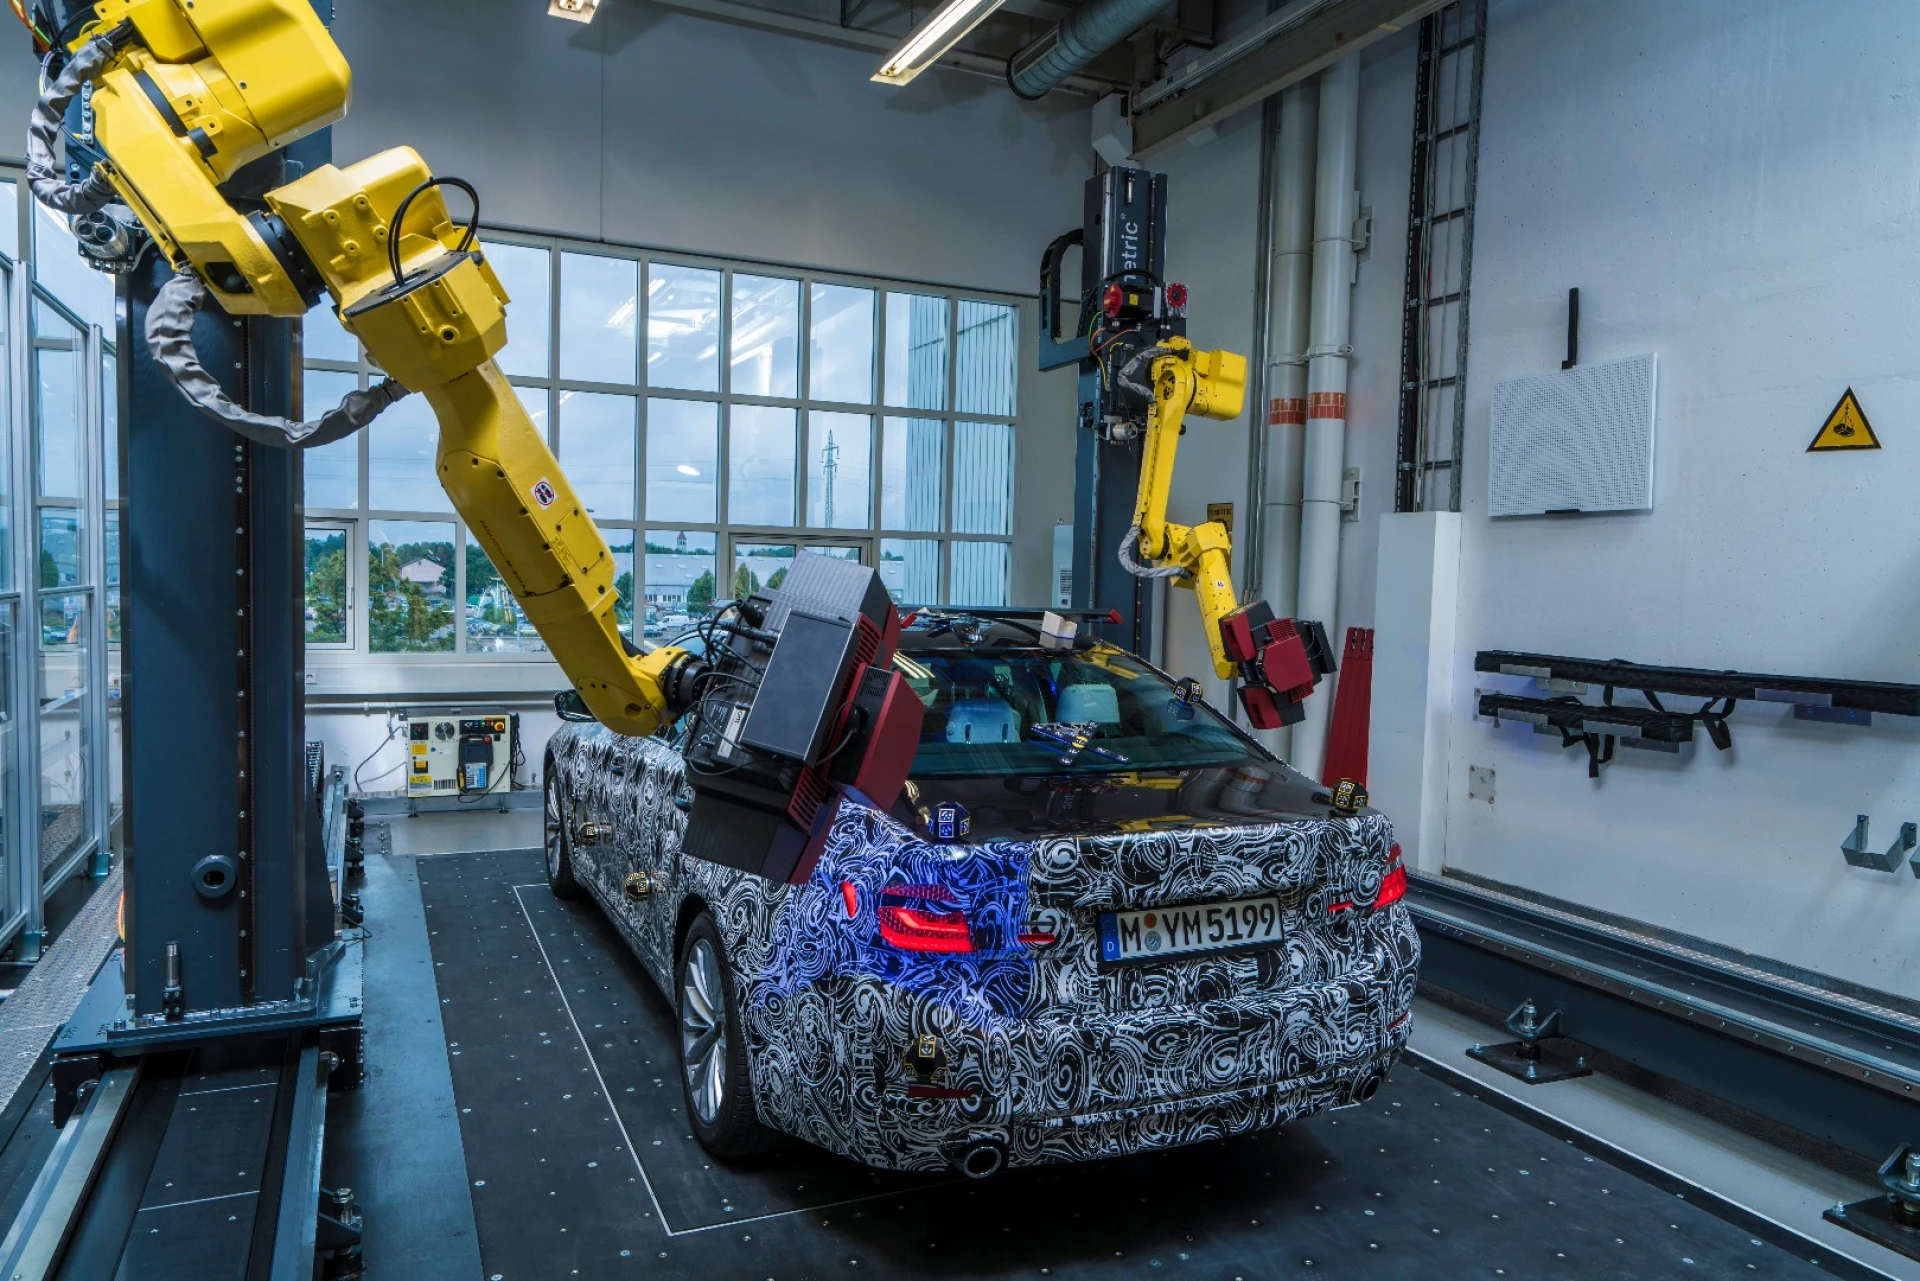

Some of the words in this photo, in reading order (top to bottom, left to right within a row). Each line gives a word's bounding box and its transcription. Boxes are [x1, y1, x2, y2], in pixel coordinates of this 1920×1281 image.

[1120, 917, 1142, 952] M
[1162, 910, 1203, 947] YM
[1207, 903, 1276, 942] 5199
[1107, 941, 1115, 952] D
